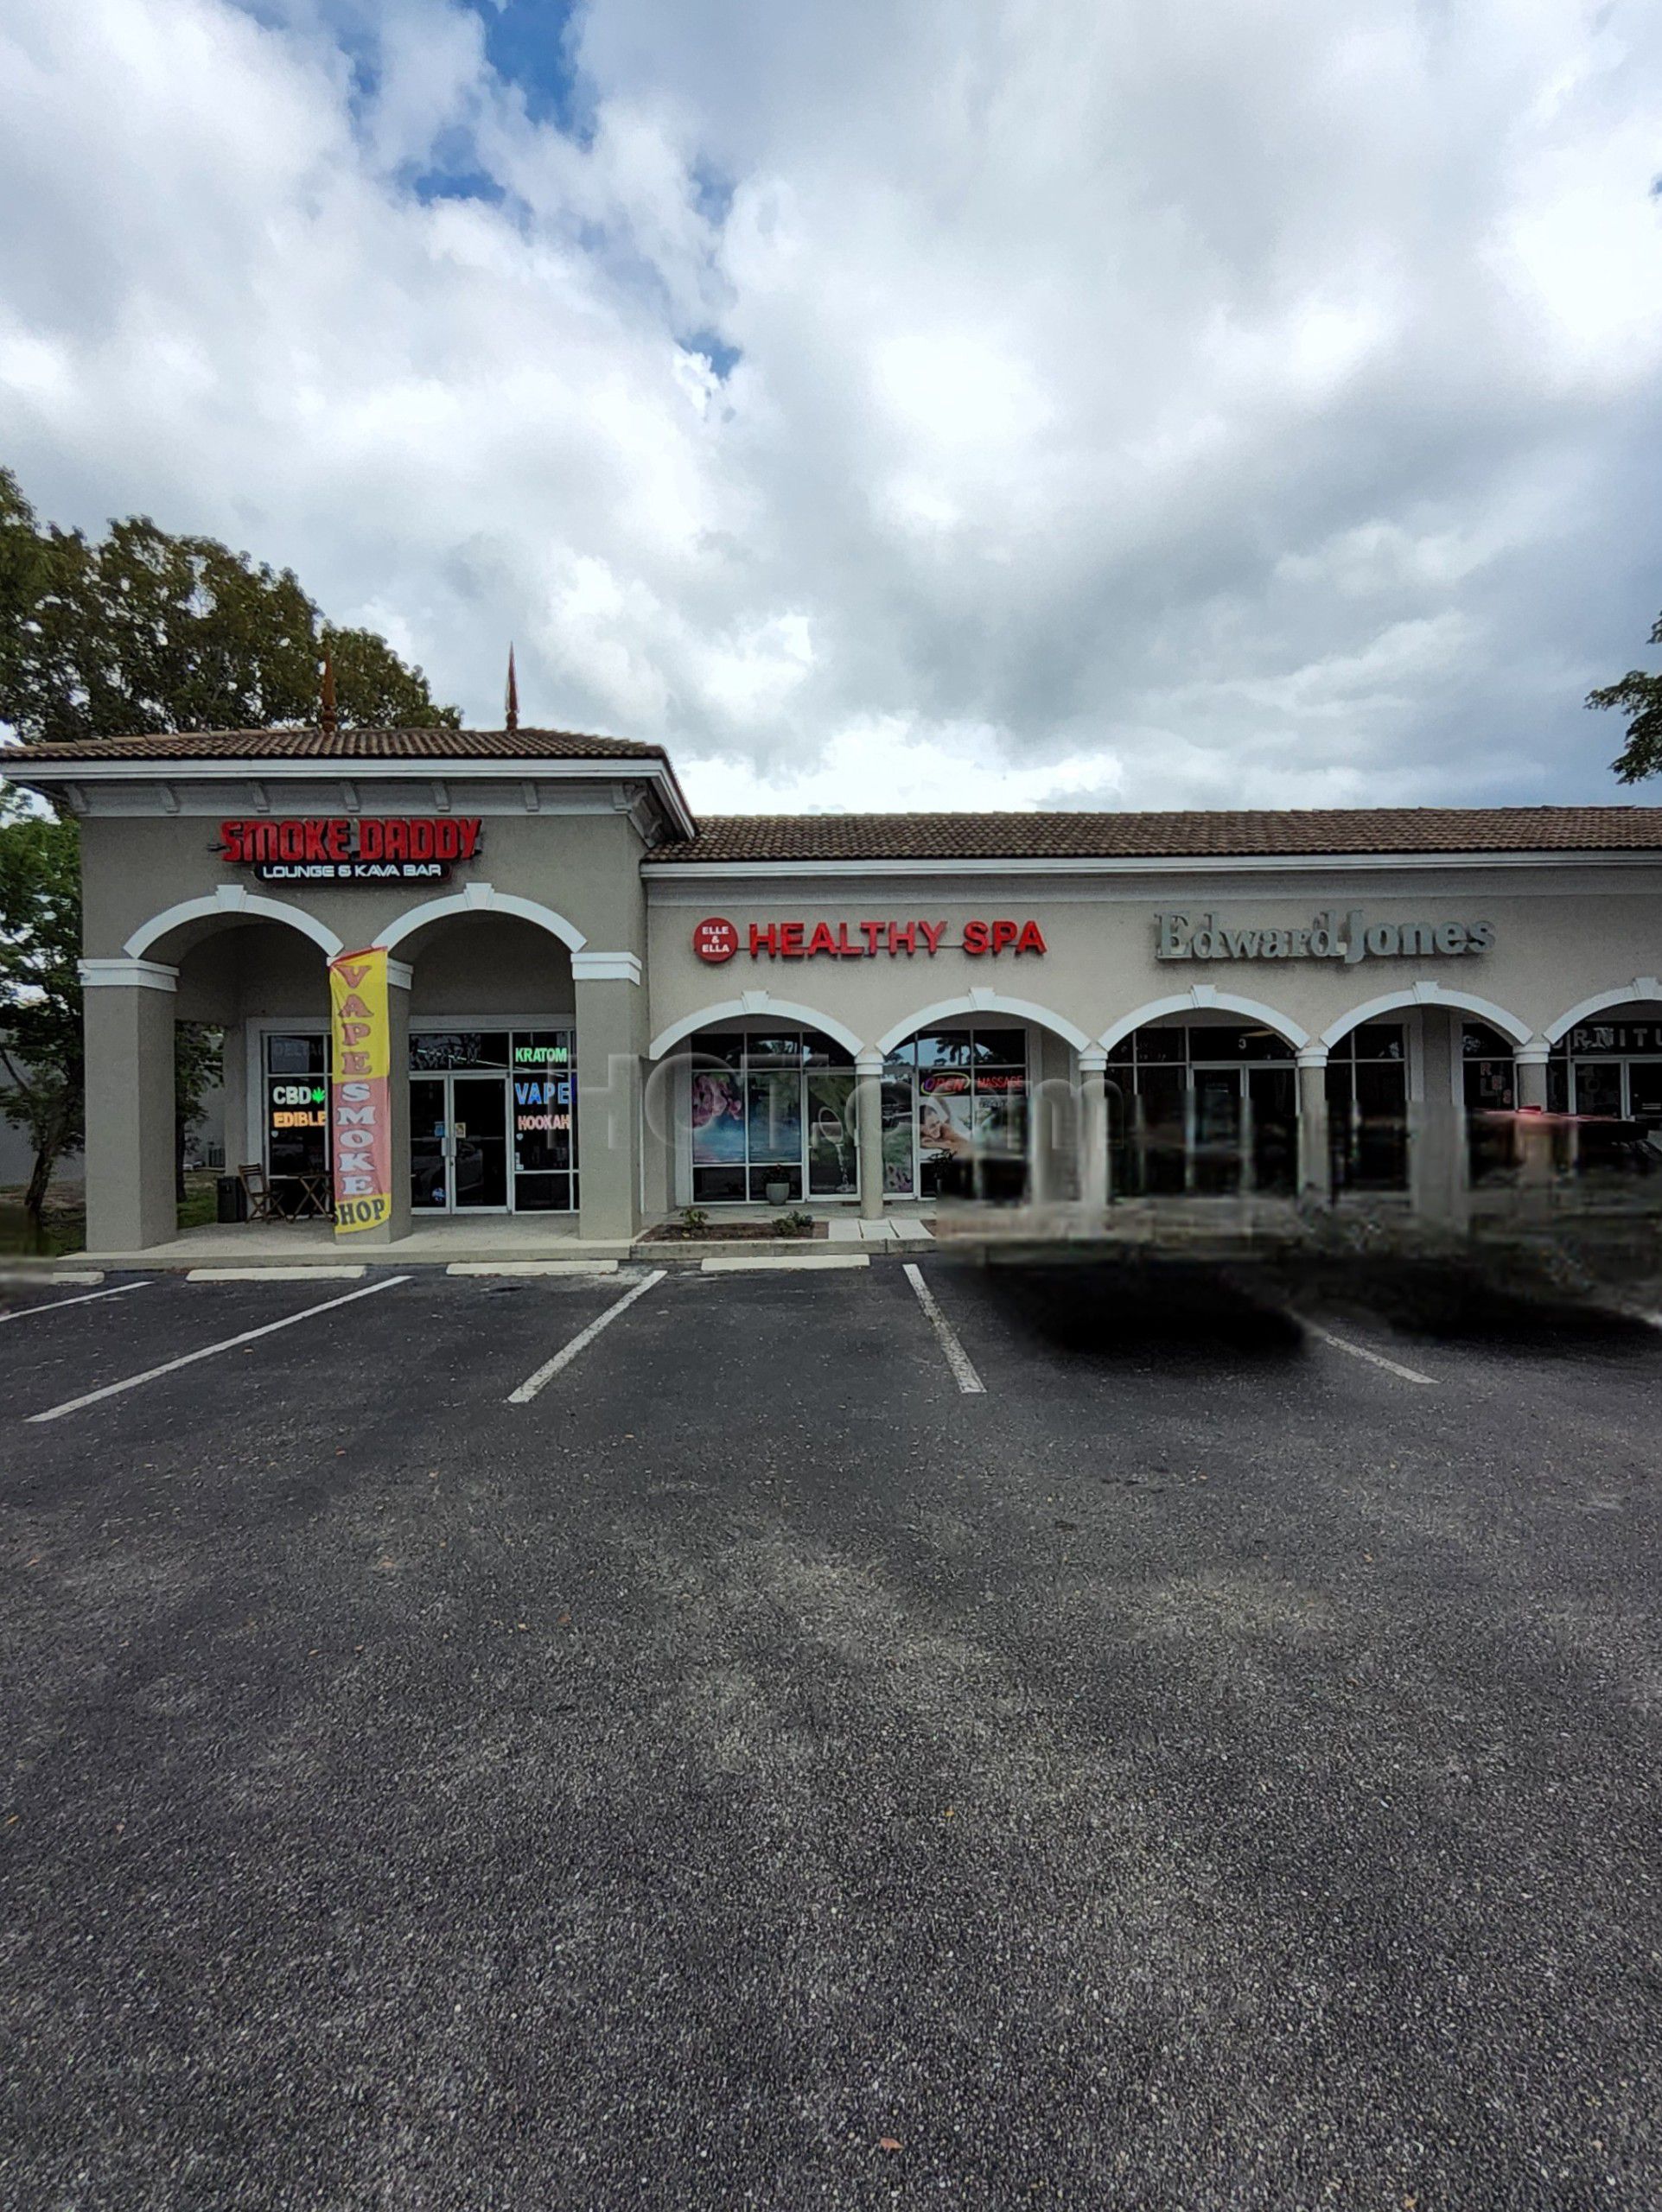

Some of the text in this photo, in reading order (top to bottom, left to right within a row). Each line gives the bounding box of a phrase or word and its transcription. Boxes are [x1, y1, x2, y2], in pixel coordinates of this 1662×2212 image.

[221, 818, 481, 861] SMOKE DADDY
[263, 865, 335, 878] LOUNGE
[354, 864, 400, 877] KAVA
[403, 863, 442, 876] BAR
[702, 926, 729, 935] ELLE
[748, 920, 1048, 957] HEALTHY SPA
[1155, 909, 1497, 963] Edward Jones
[711, 935, 720, 944] &
[702, 944, 730, 953] ELLA
[334, 964, 374, 1076] VAPE
[515, 1046, 568, 1064] KRATOM
[924, 1077, 966, 1092] OPEN
[977, 1075, 1024, 1090] MASSAGE
[272, 1085, 312, 1106] CBD
[515, 1082, 570, 1105] VAPE
[272, 1111, 327, 1128] EDIBLE
[518, 1114, 571, 1130] HOOKAH
[336, 1083, 376, 1196] SMOKE
